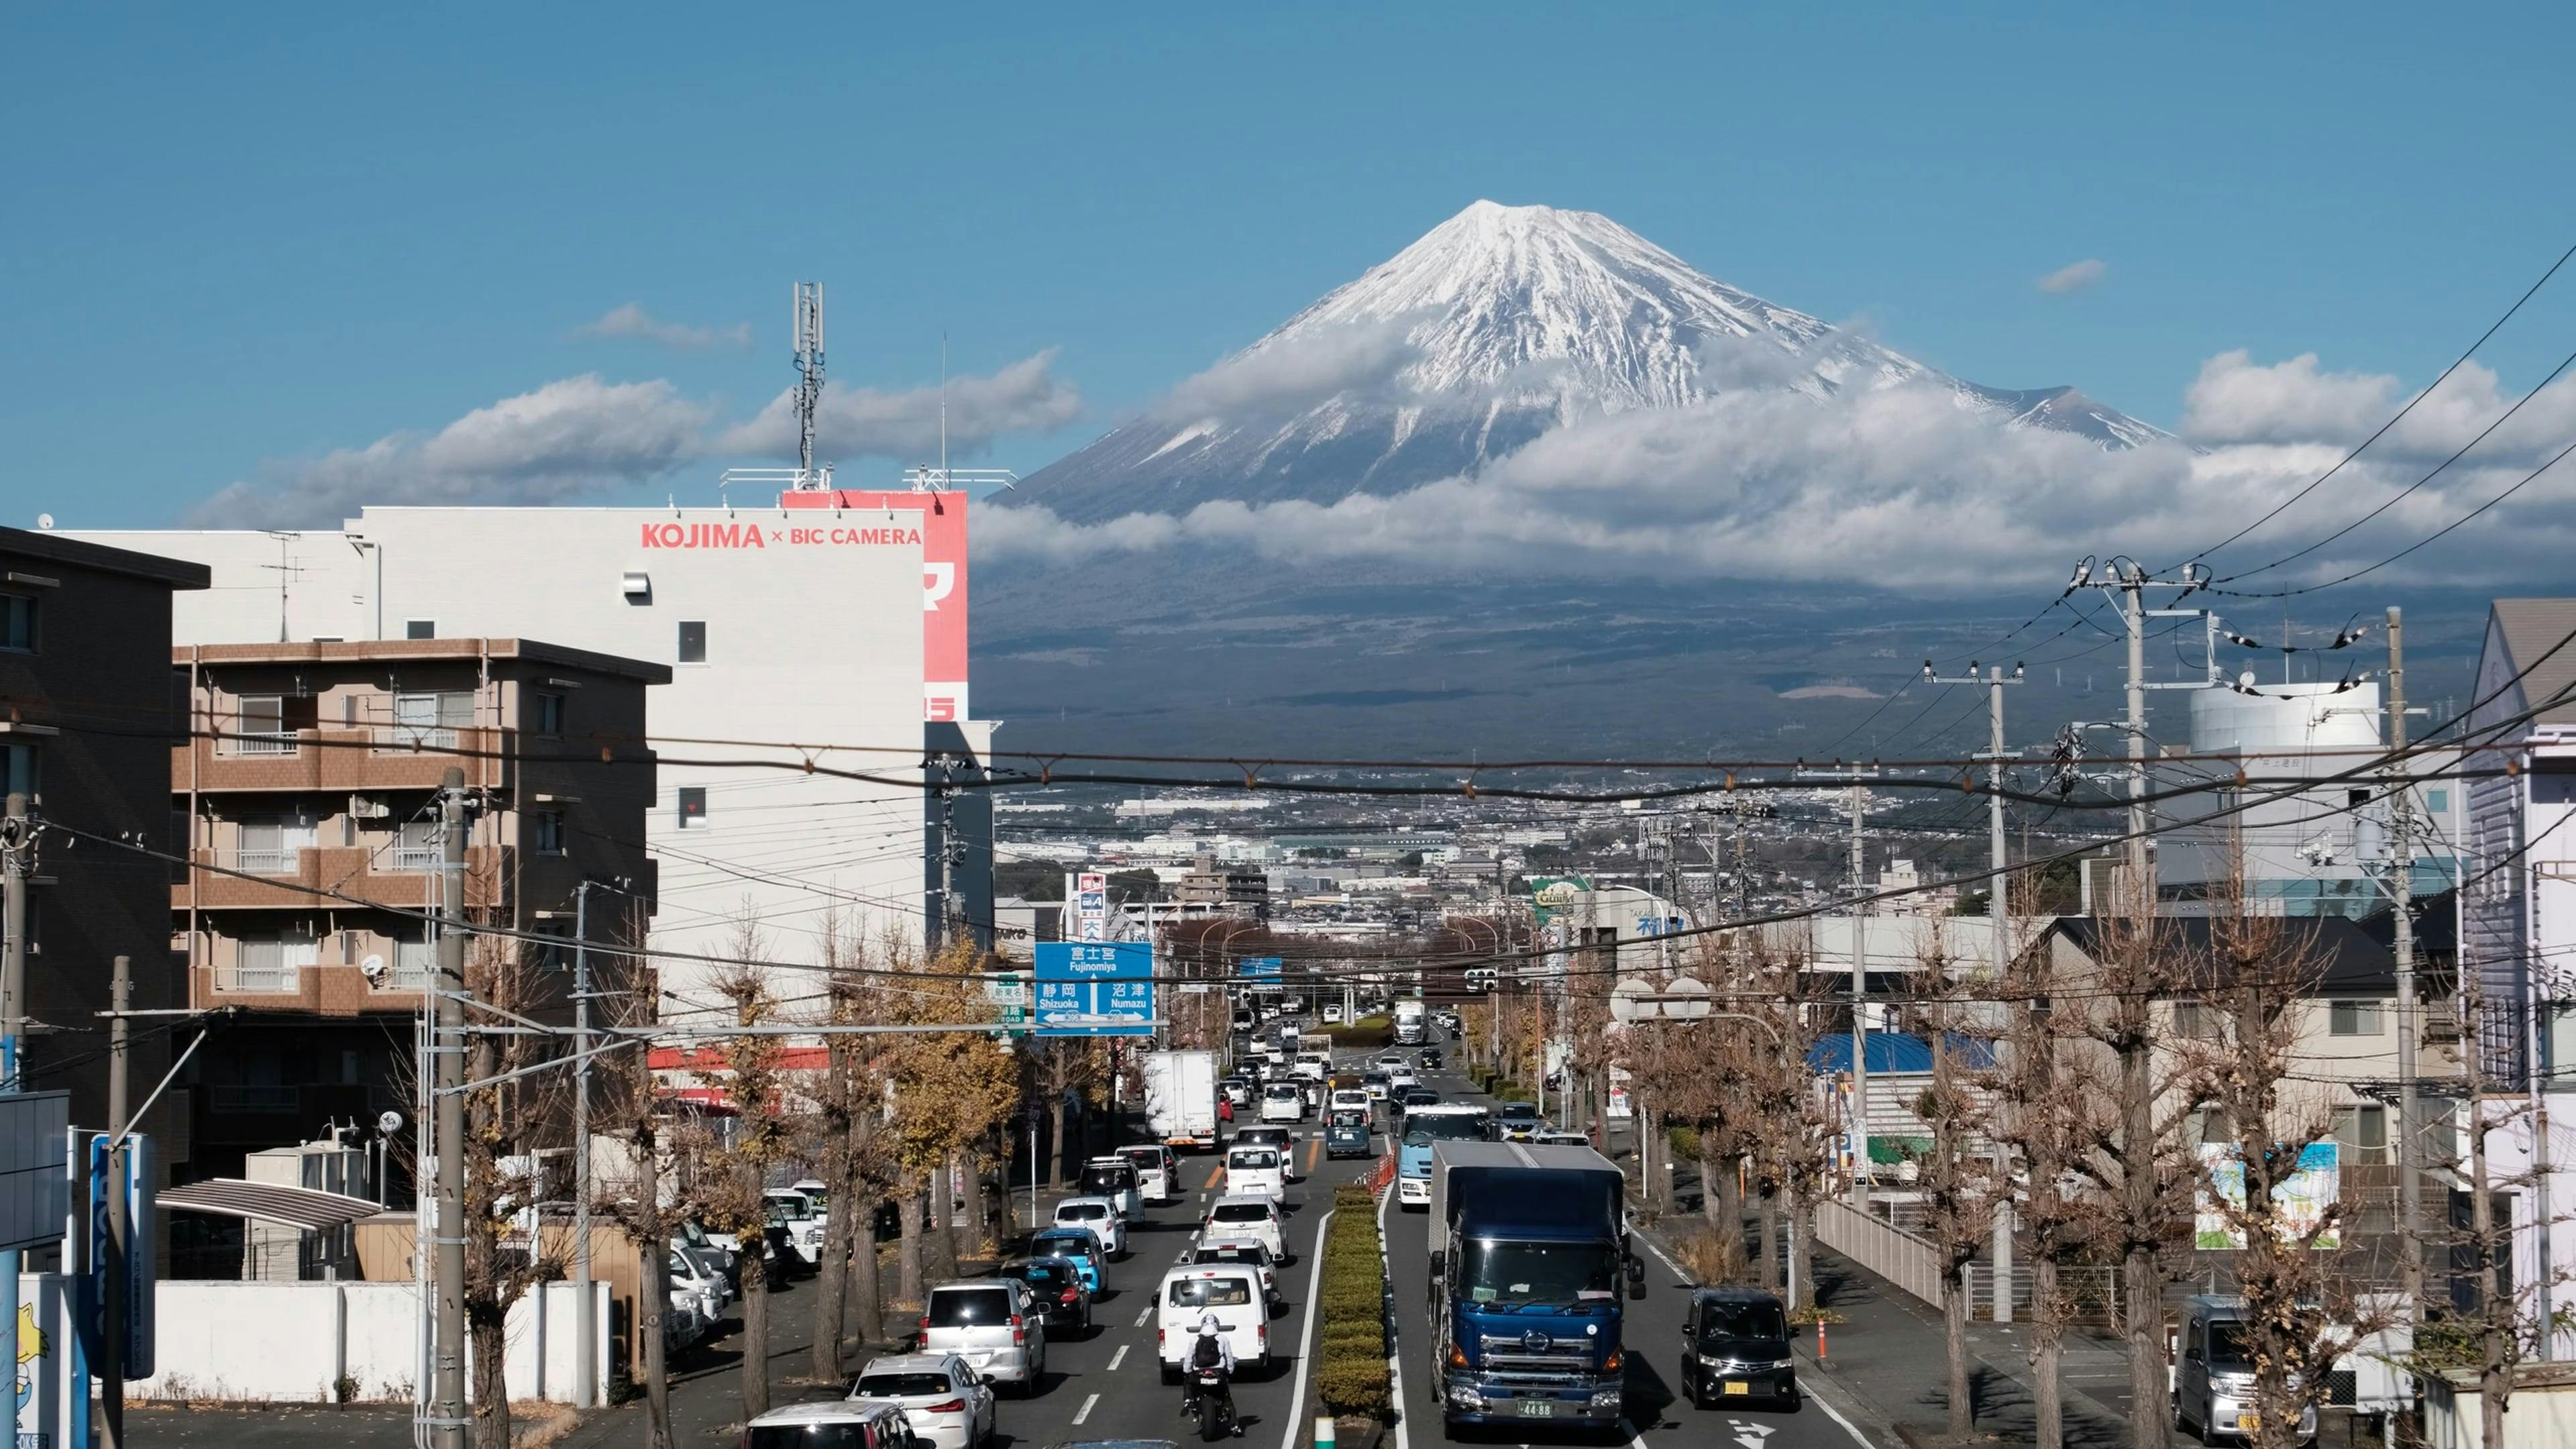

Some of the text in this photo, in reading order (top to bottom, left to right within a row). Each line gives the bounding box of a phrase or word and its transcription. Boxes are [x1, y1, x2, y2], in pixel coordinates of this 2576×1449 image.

[641, 523, 765, 548] KOJIMA
[791, 529, 824, 545] BIC
[830, 529, 922, 545] CAMERA
[1071, 947, 1116, 960] 富士宮
[1070, 961, 1117, 973] Fujinomiya
[1042, 983, 1076, 997] 静岡
[1112, 983, 1145, 997] 沼津
[1039, 998, 1079, 1008] Shizuoka
[1111, 998, 1146, 1008] Numazu
[1524, 1405, 1550, 1415] 44-88
